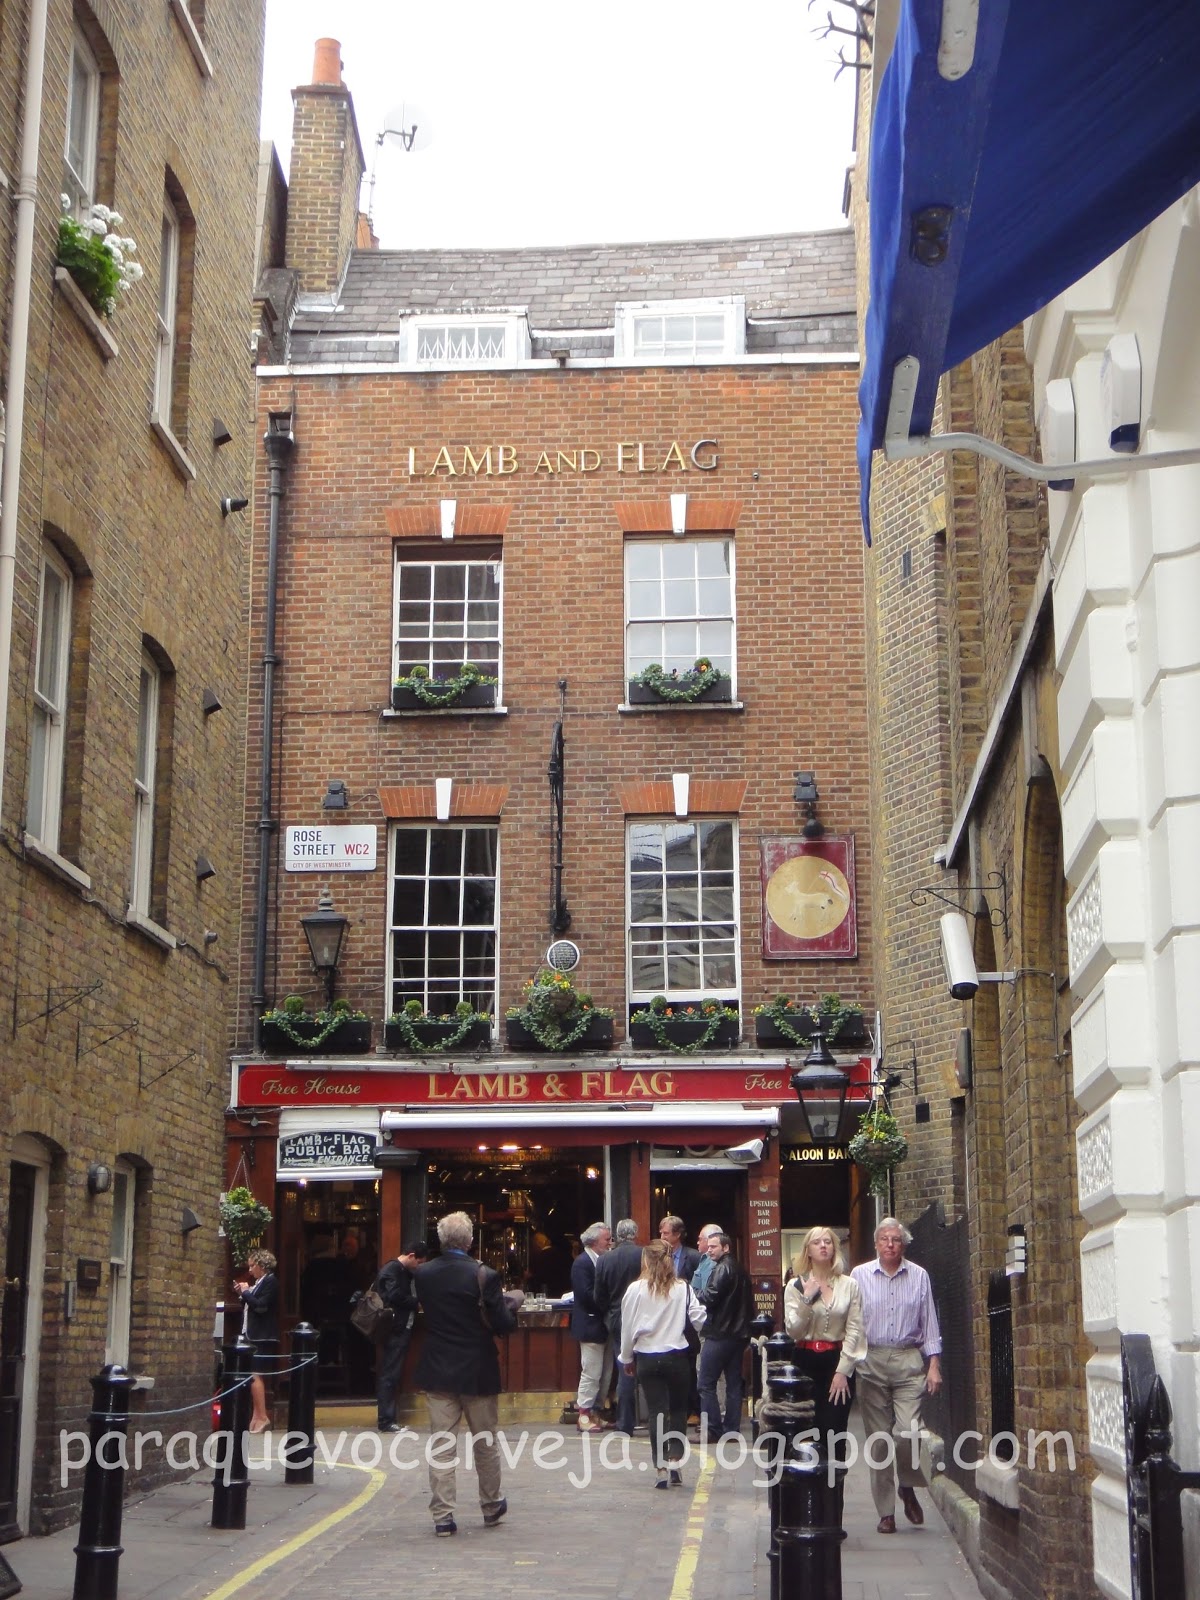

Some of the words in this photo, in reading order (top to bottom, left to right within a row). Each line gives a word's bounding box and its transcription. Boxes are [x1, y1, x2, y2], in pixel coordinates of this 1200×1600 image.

[408, 445, 519, 476] LAMB
[533, 448, 601, 474] AND
[616, 438, 720, 473] FLAG
[293, 830, 322, 842] ROSE
[293, 844, 336, 856] STREET
[344, 844, 369, 855] WC2
[261, 1079, 299, 1096] Free
[303, 1076, 361, 1095] House
[427, 1073, 529, 1099] LAMB
[542, 1073, 570, 1098] &
[580, 1071, 680, 1098] FLAG
[744, 1073, 782, 1091] Free
[290, 1134, 322, 1147] LAMB
[334, 1134, 365, 1145] FLAG
[285, 1145, 336, 1156] PUBLIC
[343, 1144, 371, 1154] BAR
[751, 1227, 778, 1239] TRADITIONAL
